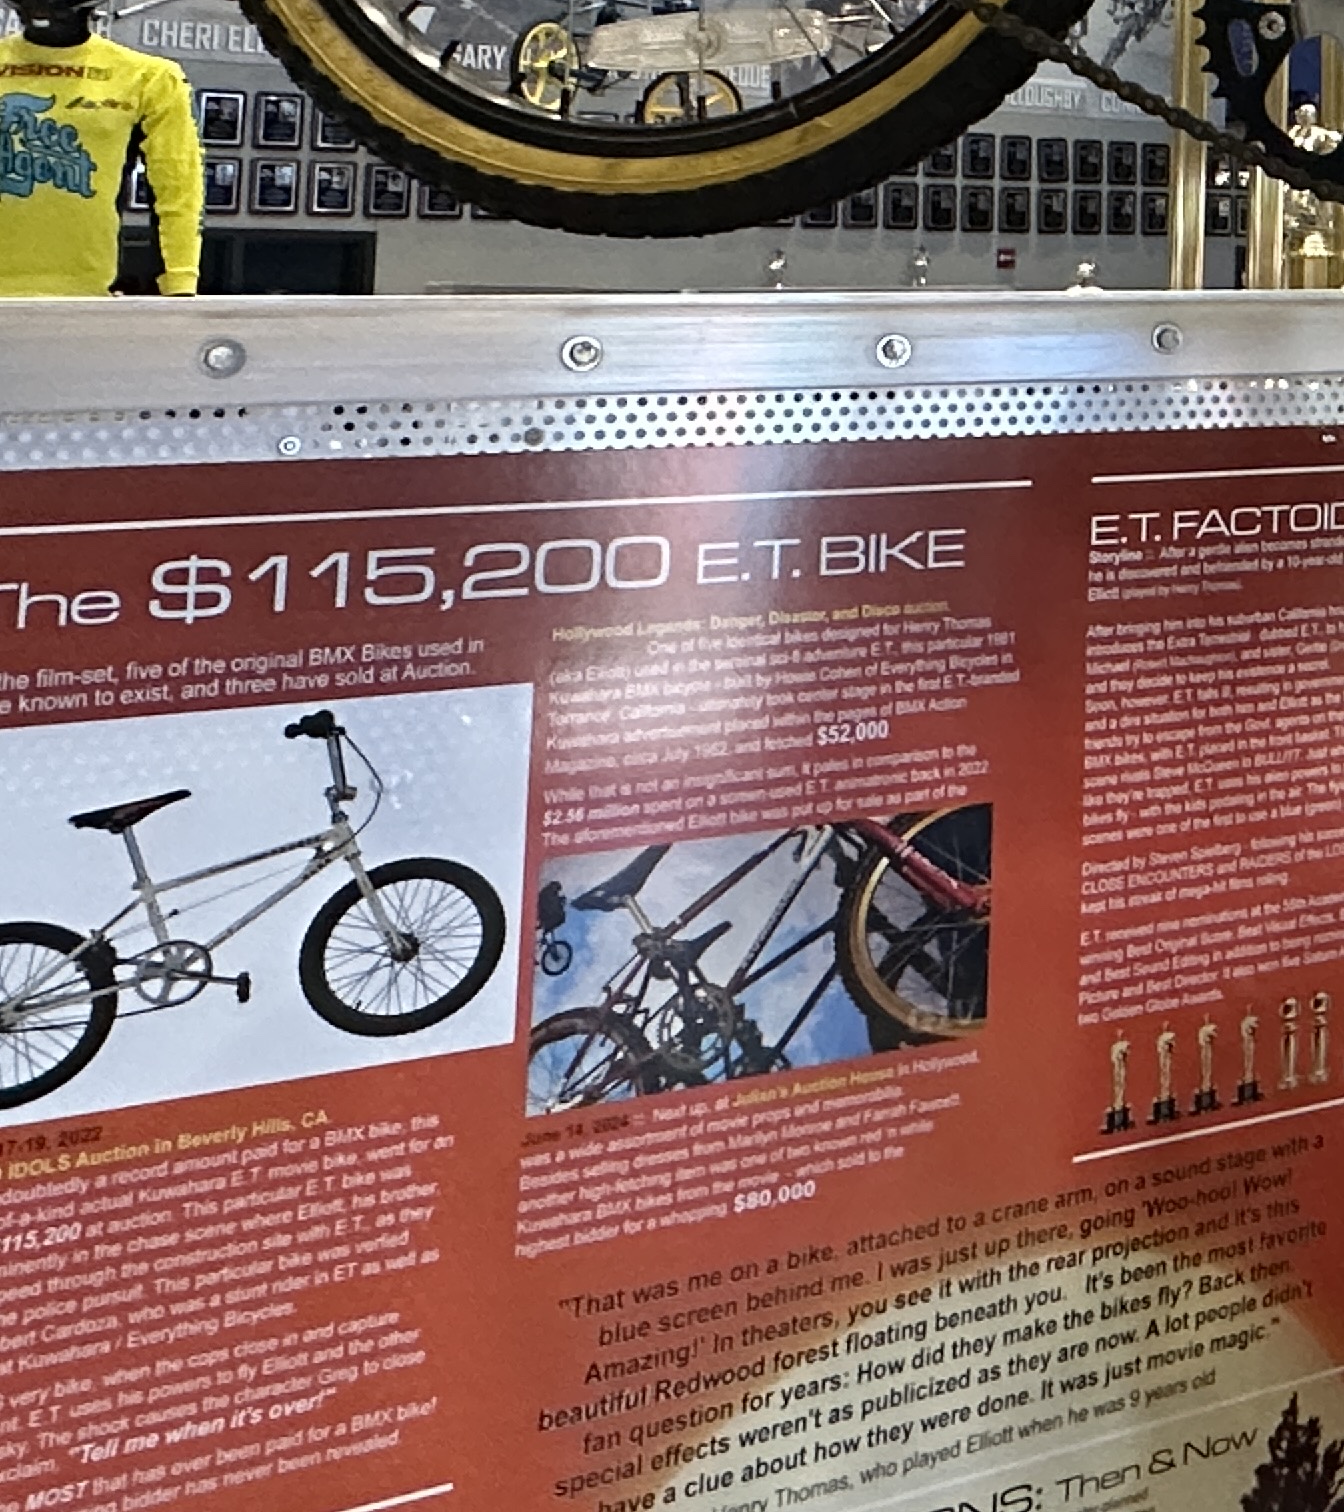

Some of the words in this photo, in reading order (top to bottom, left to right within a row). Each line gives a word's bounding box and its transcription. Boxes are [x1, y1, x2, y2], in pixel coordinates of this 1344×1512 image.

[142, 19, 220, 50] CHERI
[1090, 511, 1162, 546] E.T.
[149, 534, 670, 625] $115,200
[697, 538, 802, 584] E.T.
[819, 528, 967, 578] BIKE
[126, 662, 163, 679] five
[168, 657, 189, 677] of
[194, 658, 226, 675] the
[231, 649, 303, 674] original
[309, 645, 355, 666] BMX
[361, 644, 412, 662] Bikes
[418, 638, 463, 657] used
[468, 640, 484, 653] in
[19, 693, 88, 712] known
[95, 689, 114, 706] to
[181, 678, 219, 699] and
[225, 677, 277, 695] three
[282, 673, 329, 691] have
[335, 666, 374, 686] sold
[380, 665, 403, 682] at
[401, 662, 470, 680] Auction.
[817, 719, 890, 746] $52,000
[8, 1154, 71, 1179] IDOLS
[75, 1145, 150, 1167] Auction
[154, 1139, 172, 1153] in
[177, 1125, 247, 1149] Beverly
[733, 1180, 816, 1213] $80,000
[713, 1333, 733, 1353] In
[741, 1311, 839, 1346] theaters,
[848, 1299, 887, 1327] you
[894, 1288, 932, 1309] see
[939, 1279, 951, 1299] it
[958, 1268, 1001, 1293] with
[1008, 1261, 1040, 1282] the
[1047, 1250, 1086, 1272] rear
[1092, 1227, 1188, 1267] projection
[1195, 1212, 1229, 1237] and
[1266, 1199, 1300, 1219] this
[539, 1386, 647, 1431] beautiful
[652, 1356, 765, 1402] Redwood
[774, 1339, 839, 1373] forest
[846, 1320, 927, 1354] floating
[935, 1294, 1017, 1332] beneath
[1025, 1287, 1061, 1315] you.
[1086, 1271, 1114, 1293] It's
[1121, 1261, 1167, 1285] been
[1173, 1252, 1202, 1273] the
[1208, 1237, 1253, 1263] most
[554, 1454, 643, 1499] special
[651, 1437, 730, 1471] effects
[739, 1409, 822, 1447] weren't
[828, 1404, 853, 1424] as
[861, 1368, 971, 1421] publicized
[978, 1365, 1001, 1384] as
[1008, 1352, 1051, 1376] they
[1057, 1342, 1089, 1363] are
[1095, 1330, 1138, 1353] now.
[1145, 1319, 1160, 1339] A
[1165, 1313, 1189, 1333] lot
[1195, 1296, 1256, 1331] people
[1262, 1280, 1312, 1308] didn't
[583, 1431, 621, 1454] fan
[629, 1402, 733, 1446] question
[742, 1391, 774, 1413] for
[781, 1373, 849, 1410] years:
[857, 1359, 904, 1384] How
[911, 1342, 945, 1369] did
[952, 1335, 996, 1359] they
[1003, 1319, 1057, 1346] make
[1063, 1309, 1094, 1330] the
[1101, 1295, 1151, 1320] bikes
[1158, 1279, 1193, 1308] fly?
[1199, 1271, 1245, 1295] Back
[123, 1433, 159, 1453] me
[165, 1417, 225, 1444] when
[230, 1407, 263, 1428] it's
[599, 1493, 655, 1512] have
[663, 1487, 675, 1504] a
[685, 1471, 733, 1497] clue
[741, 1447, 807, 1482] about
[814, 1436, 861, 1463] how
[867, 1421, 913, 1447] they
[921, 1406, 971, 1433] were
[977, 1391, 1029, 1417] done.
[1041, 1379, 1053, 1400] It
[1060, 1371, 1098, 1394] was
[1103, 1356, 1141, 1388] just
[1147, 1341, 1204, 1370] movie
[1055, 1463, 1140, 1502] Then
[1147, 1448, 1176, 1475] &
[1182, 1427, 1259, 1466] Now
